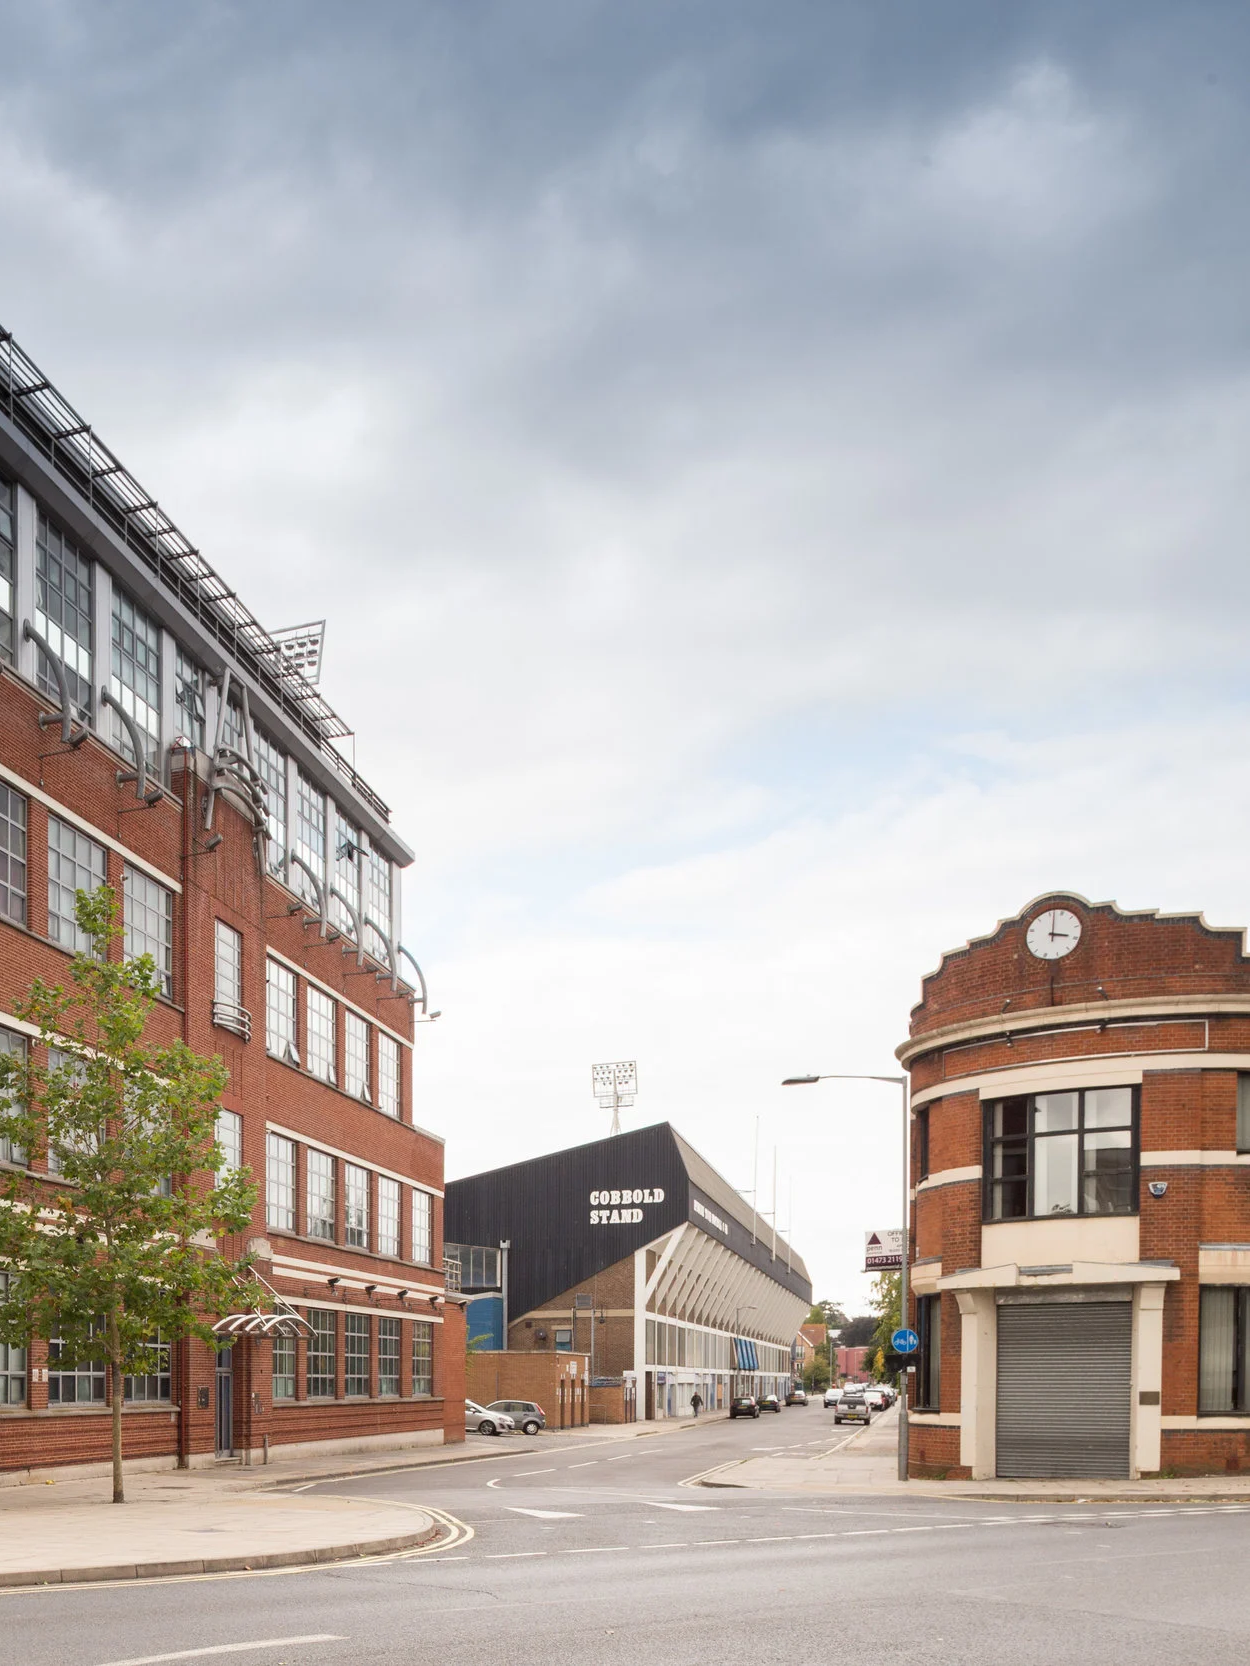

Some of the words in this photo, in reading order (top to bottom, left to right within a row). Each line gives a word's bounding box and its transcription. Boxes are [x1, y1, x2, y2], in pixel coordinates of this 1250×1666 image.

[589, 1188, 665, 1206] COBBOLD
[589, 1208, 644, 1225] STAND
[866, 1256, 887, 1265] 01473
[887, 1255, 903, 1264] 2119
